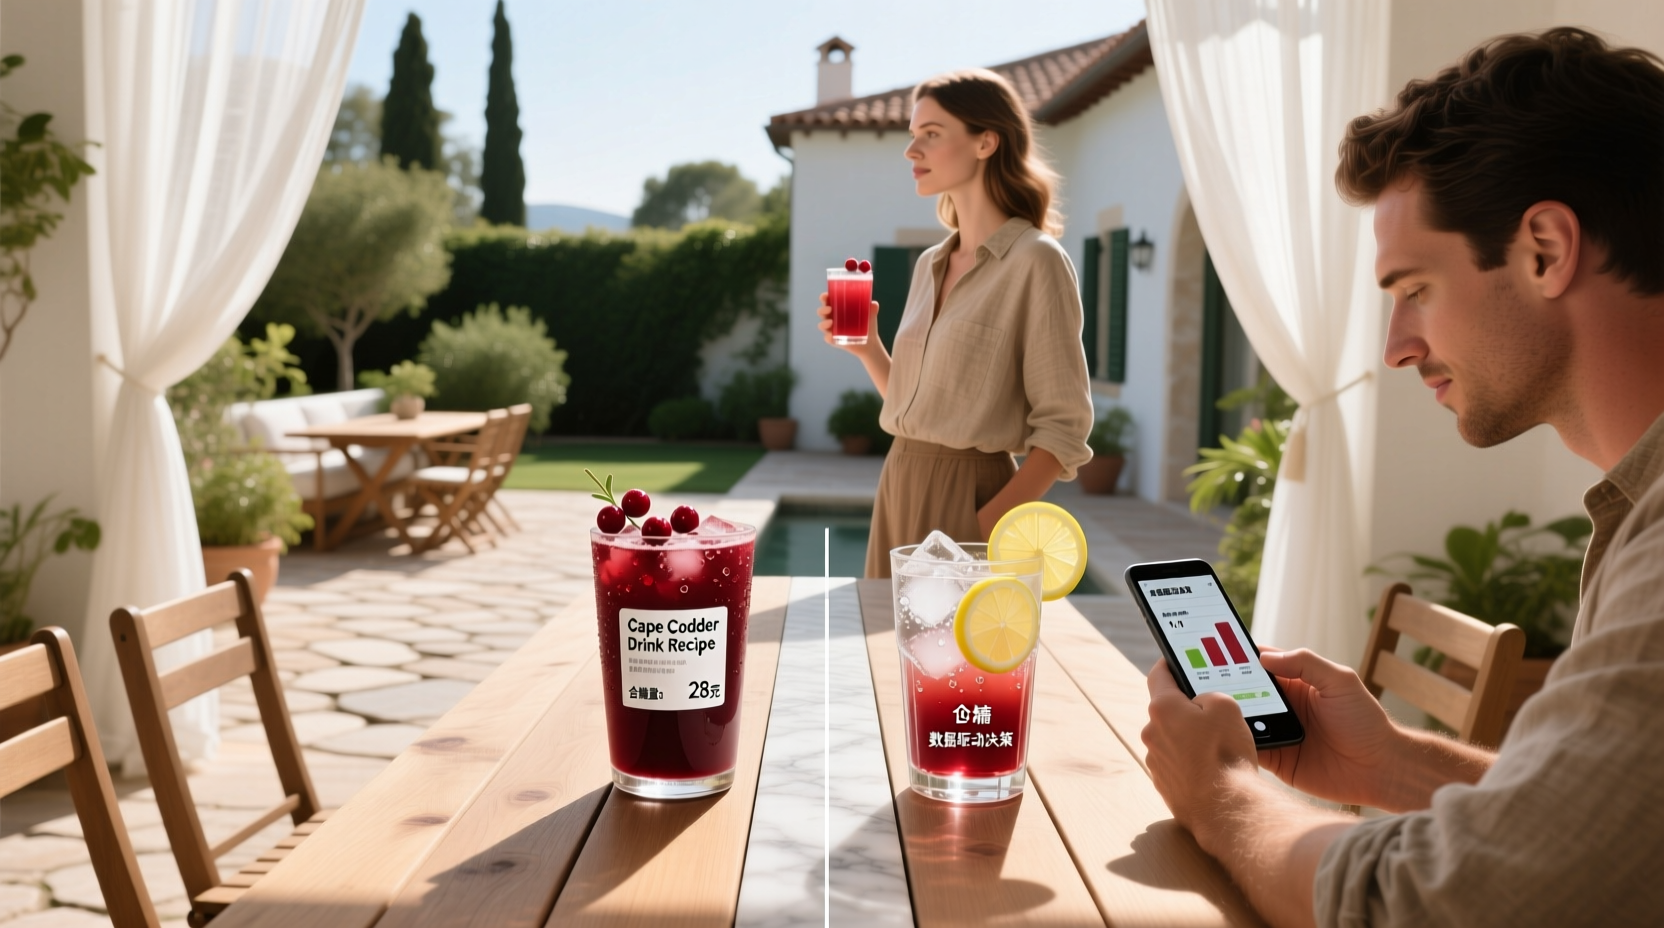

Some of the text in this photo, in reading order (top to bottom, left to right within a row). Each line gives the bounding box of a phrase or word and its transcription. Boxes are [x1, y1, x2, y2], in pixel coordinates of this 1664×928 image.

[628, 618, 719, 637] Cape Codder
[628, 637, 716, 656] Drink Recipe
[688, 681, 720, 699] 28元
